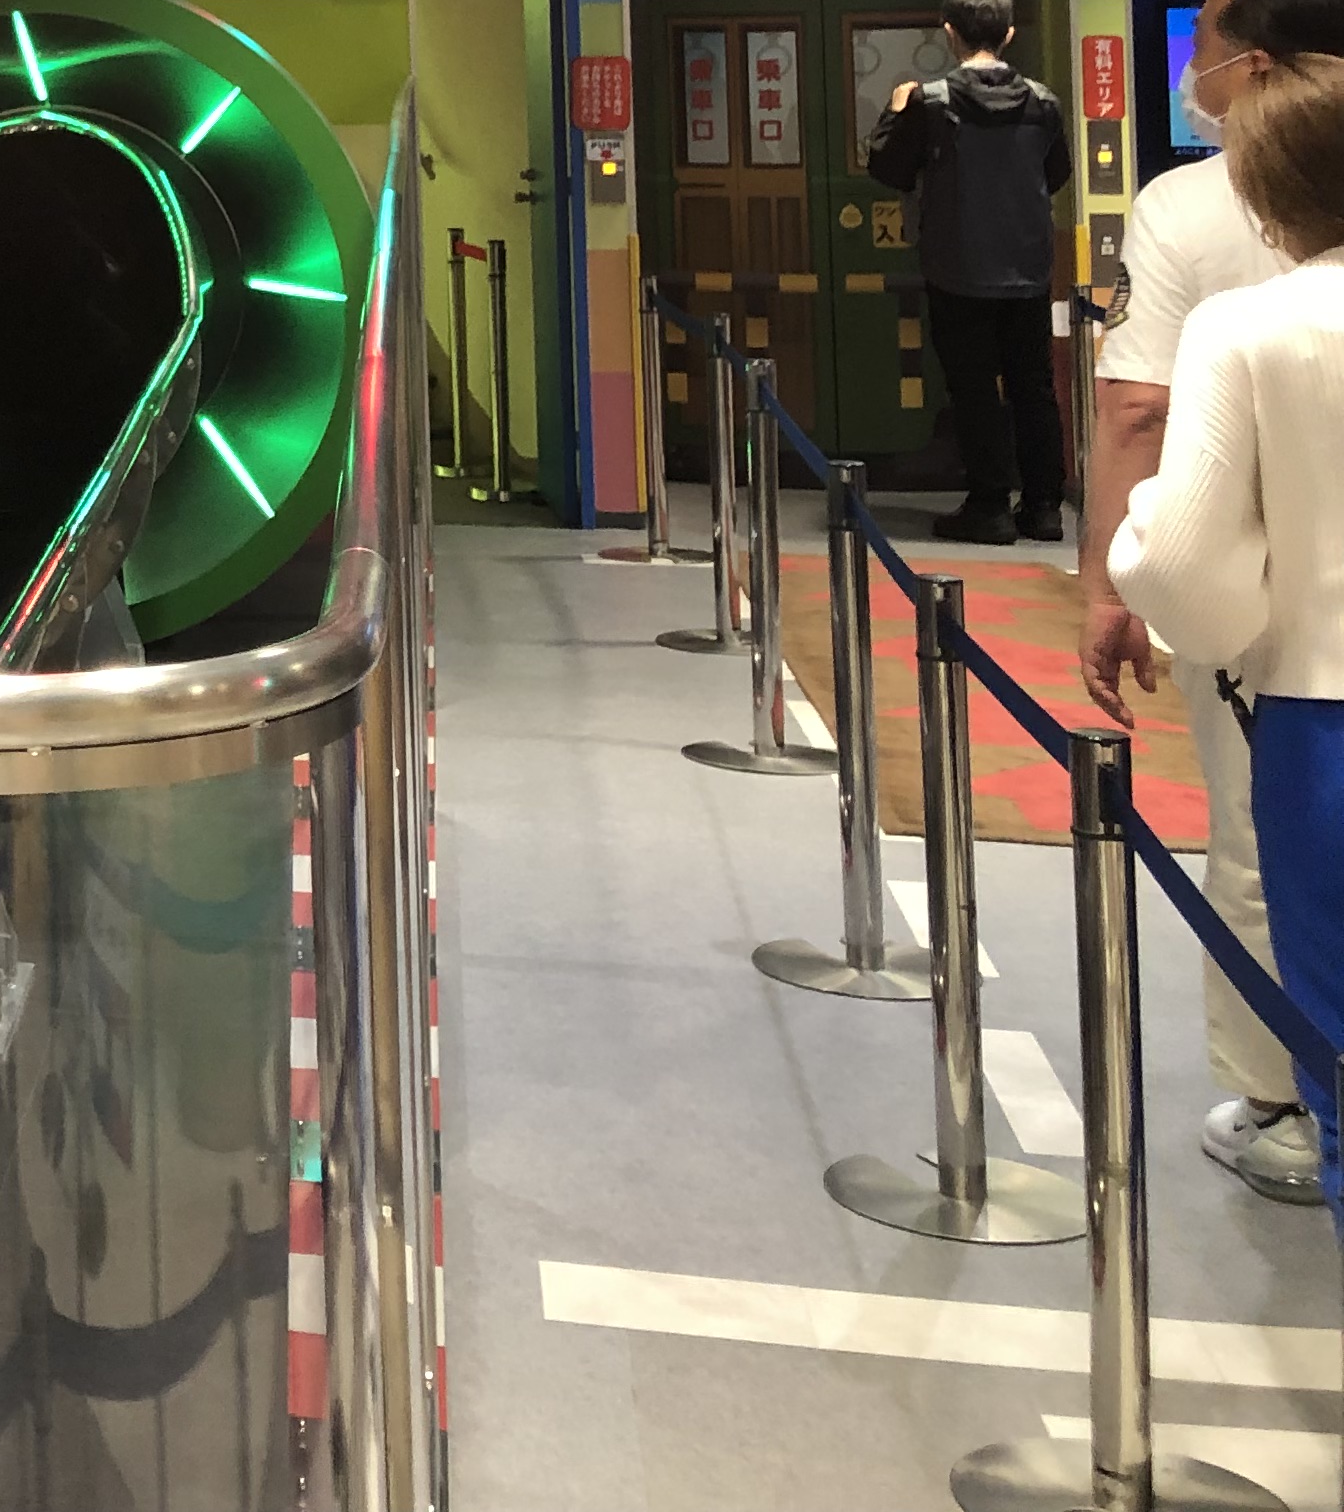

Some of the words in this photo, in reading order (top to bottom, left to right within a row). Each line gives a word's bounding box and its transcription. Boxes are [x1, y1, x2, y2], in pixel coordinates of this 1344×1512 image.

[1094, 39, 1115, 118] 有料エリア
